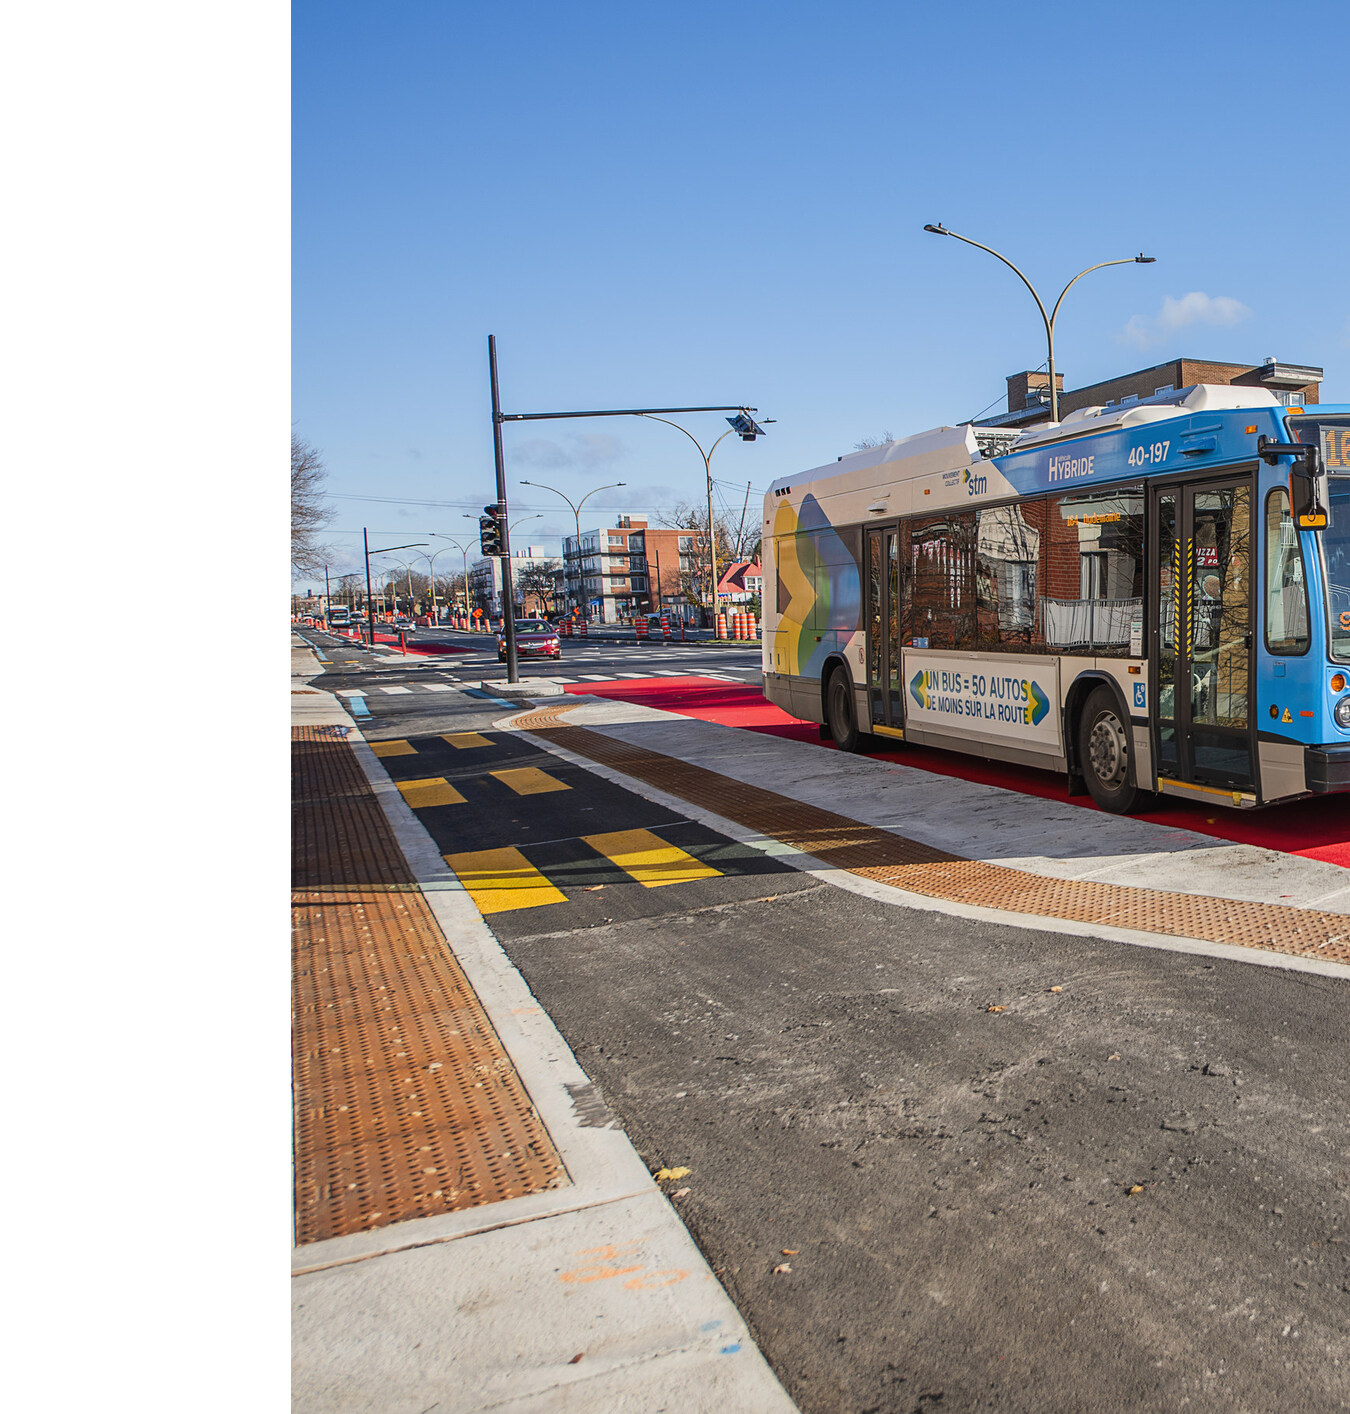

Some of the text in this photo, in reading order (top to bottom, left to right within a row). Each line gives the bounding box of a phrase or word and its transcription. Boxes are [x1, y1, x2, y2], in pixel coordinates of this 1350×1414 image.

[1127, 440, 1171, 467] 40-197
[1048, 455, 1095, 482] HYBRIDE
[968, 473, 987, 496] stm
[1066, 514, 1079, 527] 164
[925, 670, 939, 691] UN
[942, 672, 962, 694] BUS
[972, 674, 986, 697] 50
[989, 676, 1029, 702] AUTOS
[926, 694, 1030, 725] DE MOINS SUR LA ROUTE
